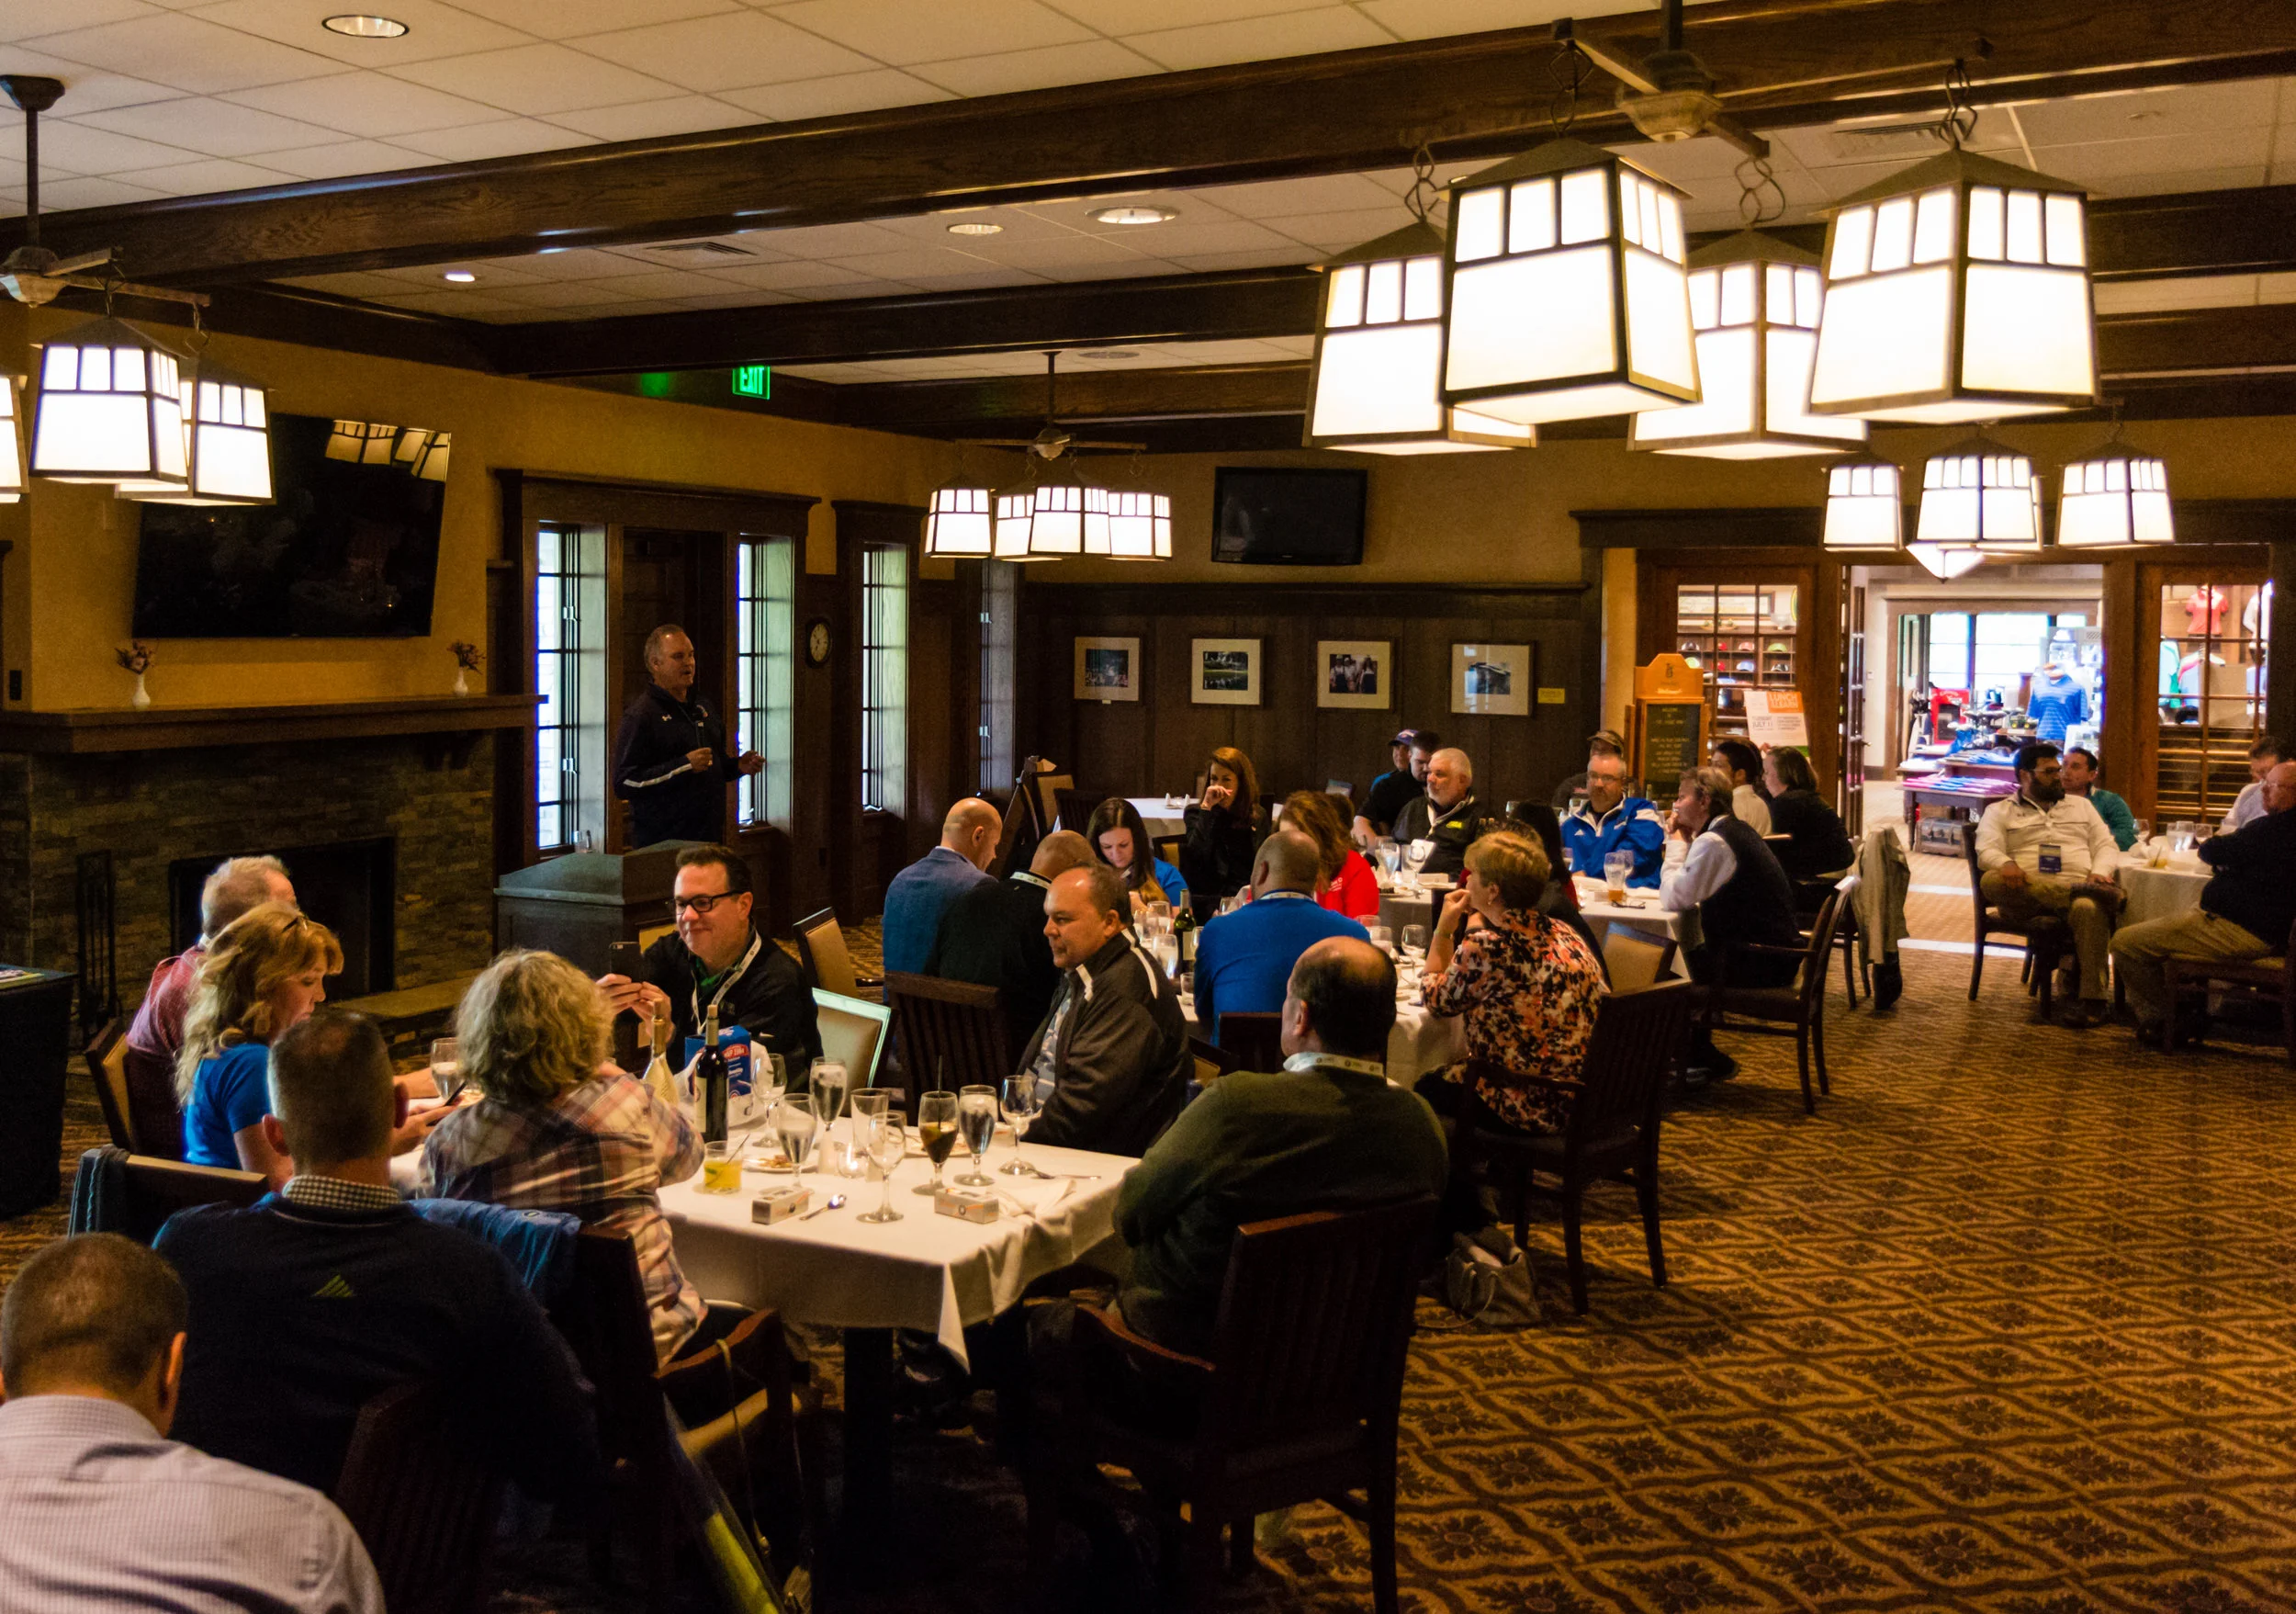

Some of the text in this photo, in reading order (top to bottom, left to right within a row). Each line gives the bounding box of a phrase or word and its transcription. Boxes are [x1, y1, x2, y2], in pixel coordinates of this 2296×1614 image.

[740, 366, 764, 394] EXIT
[1769, 692, 1797, 700] LUNCH
[1752, 720, 1766, 728] JULY
